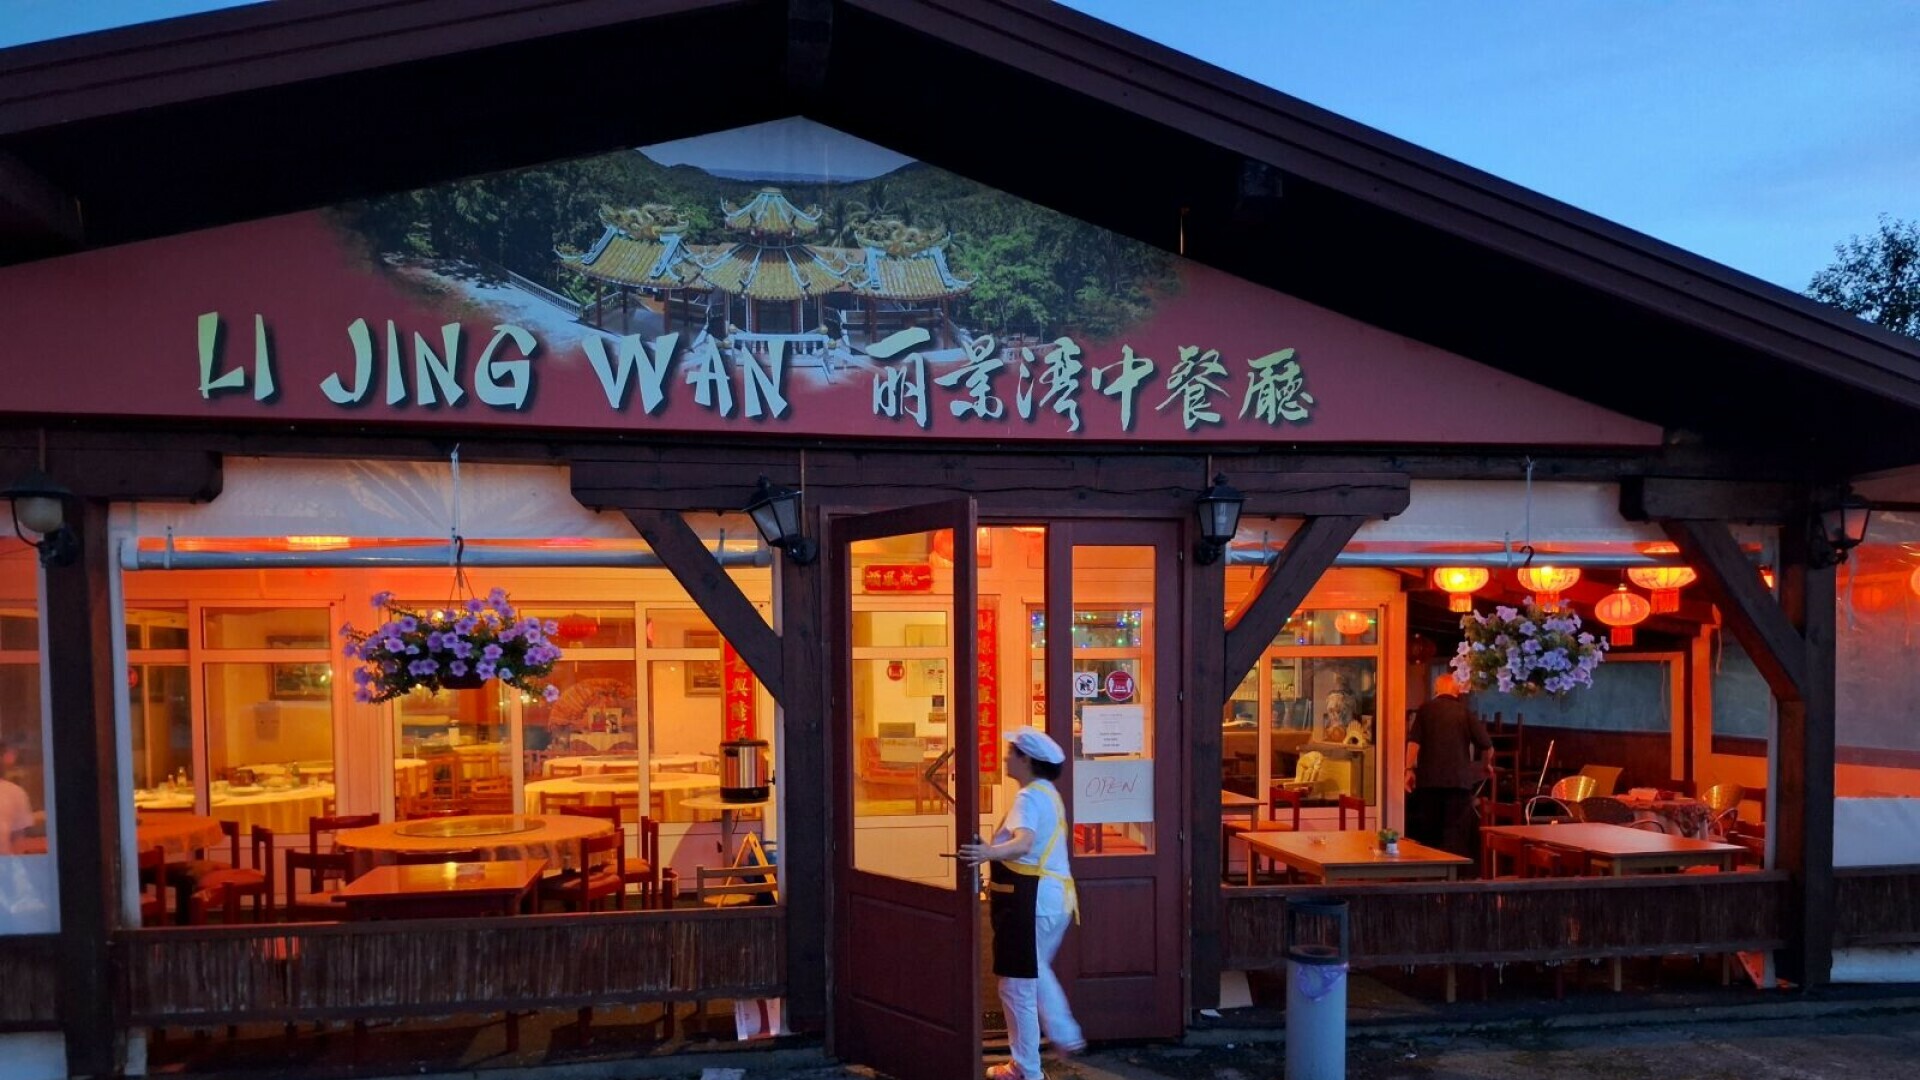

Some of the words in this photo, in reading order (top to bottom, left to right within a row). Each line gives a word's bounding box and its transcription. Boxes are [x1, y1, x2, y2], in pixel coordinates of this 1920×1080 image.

[198, 311, 272, 400] LI
[319, 318, 538, 410] JING
[583, 331, 788, 419] WAN
[1085, 772, 1139, 798] OPEN
